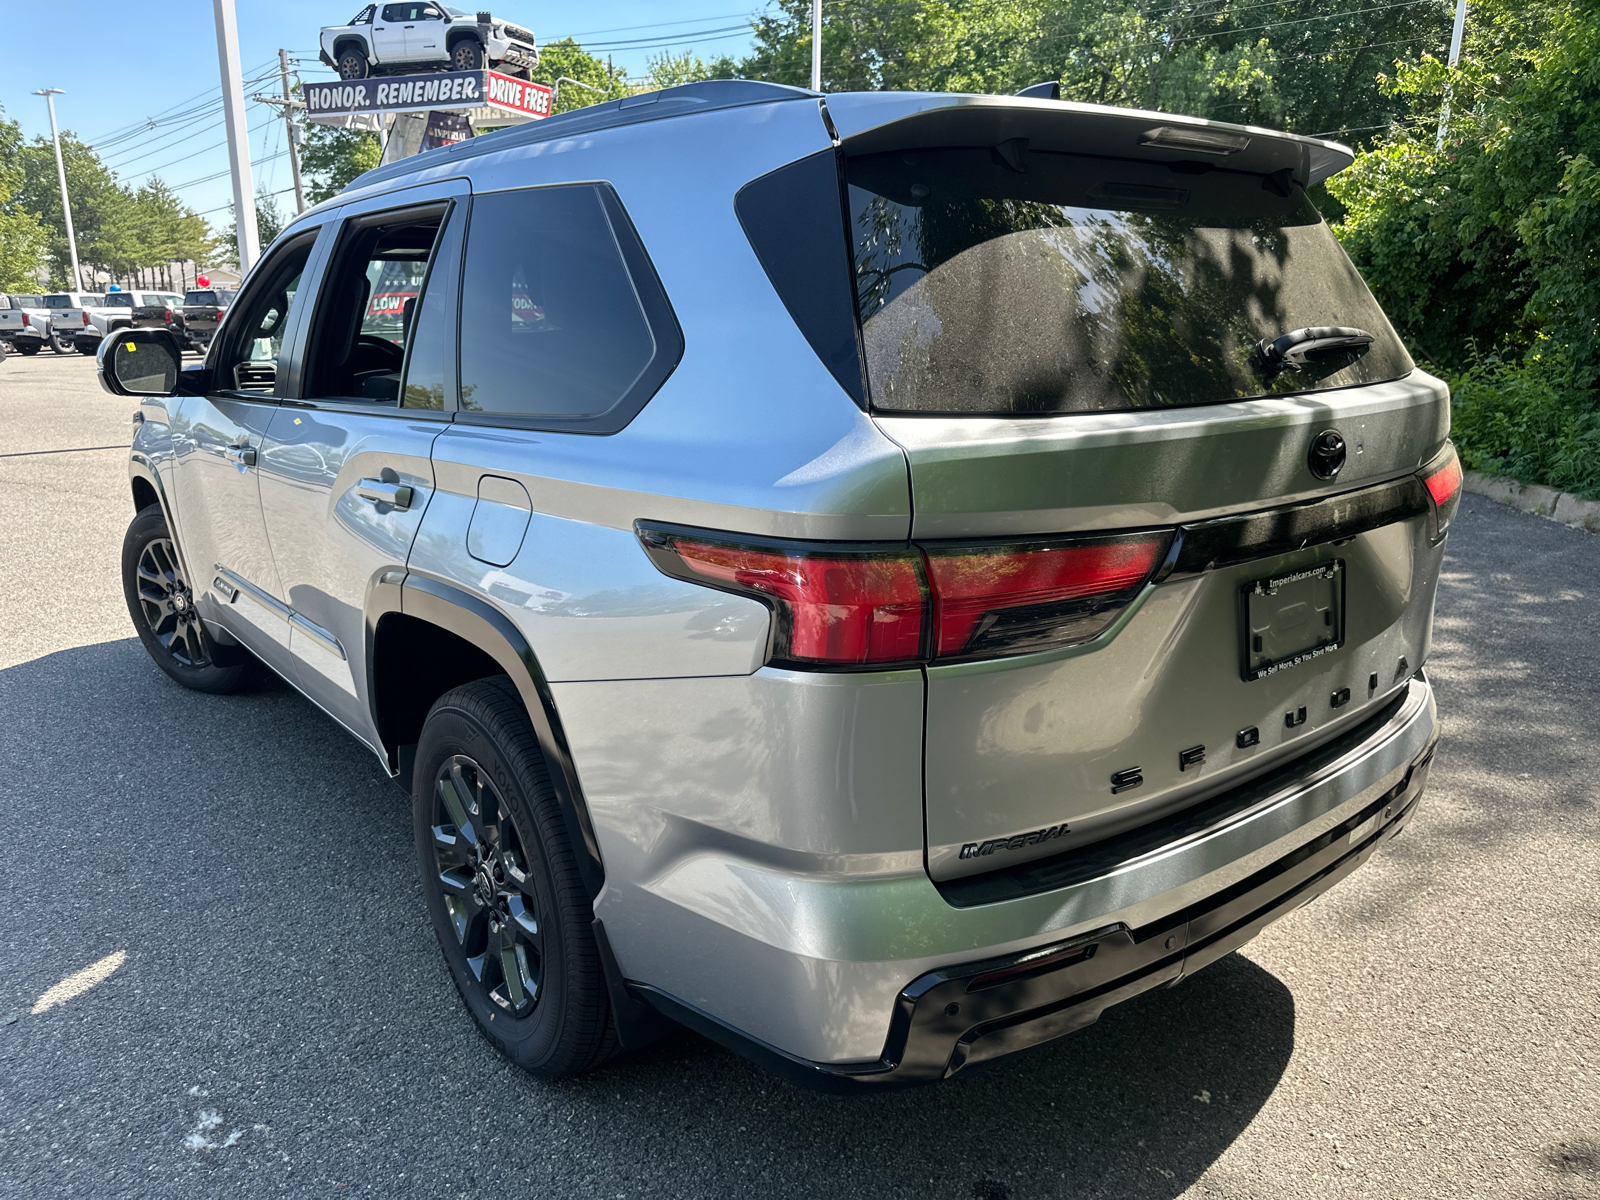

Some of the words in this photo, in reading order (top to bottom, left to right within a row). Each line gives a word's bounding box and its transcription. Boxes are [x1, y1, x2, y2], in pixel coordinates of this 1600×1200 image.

[309, 84, 370, 110] HONOR.
[377, 76, 480, 106] REMEMBER.
[489, 77, 522, 107] DRIVE
[523, 86, 550, 114] FREE
[373, 296, 400, 311] LOW
[1269, 566, 1326, 588] Imperialcars.com
[1257, 669, 1267, 679] We
[1268, 665, 1278, 676] Sell
[1279, 660, 1294, 671] More,
[1294, 656, 1302, 665] So
[1302, 652, 1312, 661] You
[1312, 647, 1325, 658] Save
[1325, 643, 1338, 653] More
[1110, 654, 1408, 795] SEQUOIA
[492, 758, 543, 878] YOKOHAMA
[959, 823, 1071, 860] IMPERIAL
